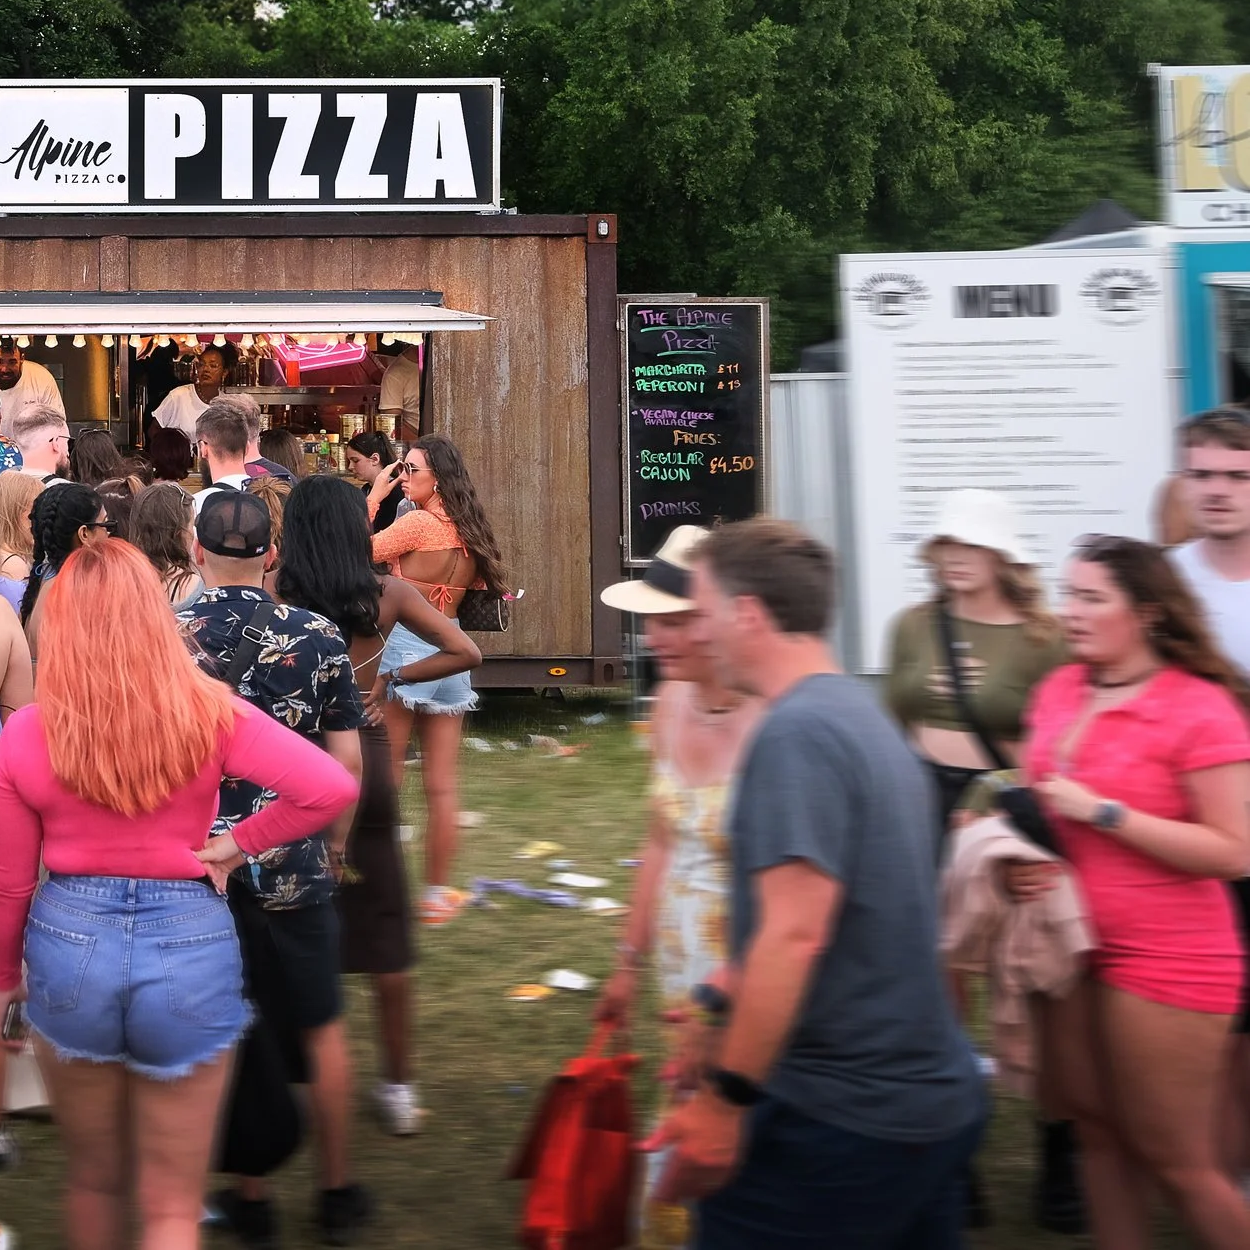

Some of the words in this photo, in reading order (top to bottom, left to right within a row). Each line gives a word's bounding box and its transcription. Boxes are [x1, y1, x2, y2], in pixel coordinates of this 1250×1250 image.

[0, 119, 112, 180] Alpine
[144, 93, 477, 199] PIZZA
[55, 174, 100, 183] PIZZA
[637, 310, 669, 325] THE
[676, 308, 733, 326] ALPINE
[662, 330, 720, 350] PIZZA
[635, 379, 705, 394] PEPERONI
[640, 409, 678, 419] VEGAN
[680, 411, 715, 420] CHEESE
[644, 418, 698, 428] AVAILABLE
[641, 450, 704, 465] REGULAR
[709, 456, 755, 474] £4.50
[640, 466, 690, 481] CAJUN
[639, 502, 701, 519] DRINKS
